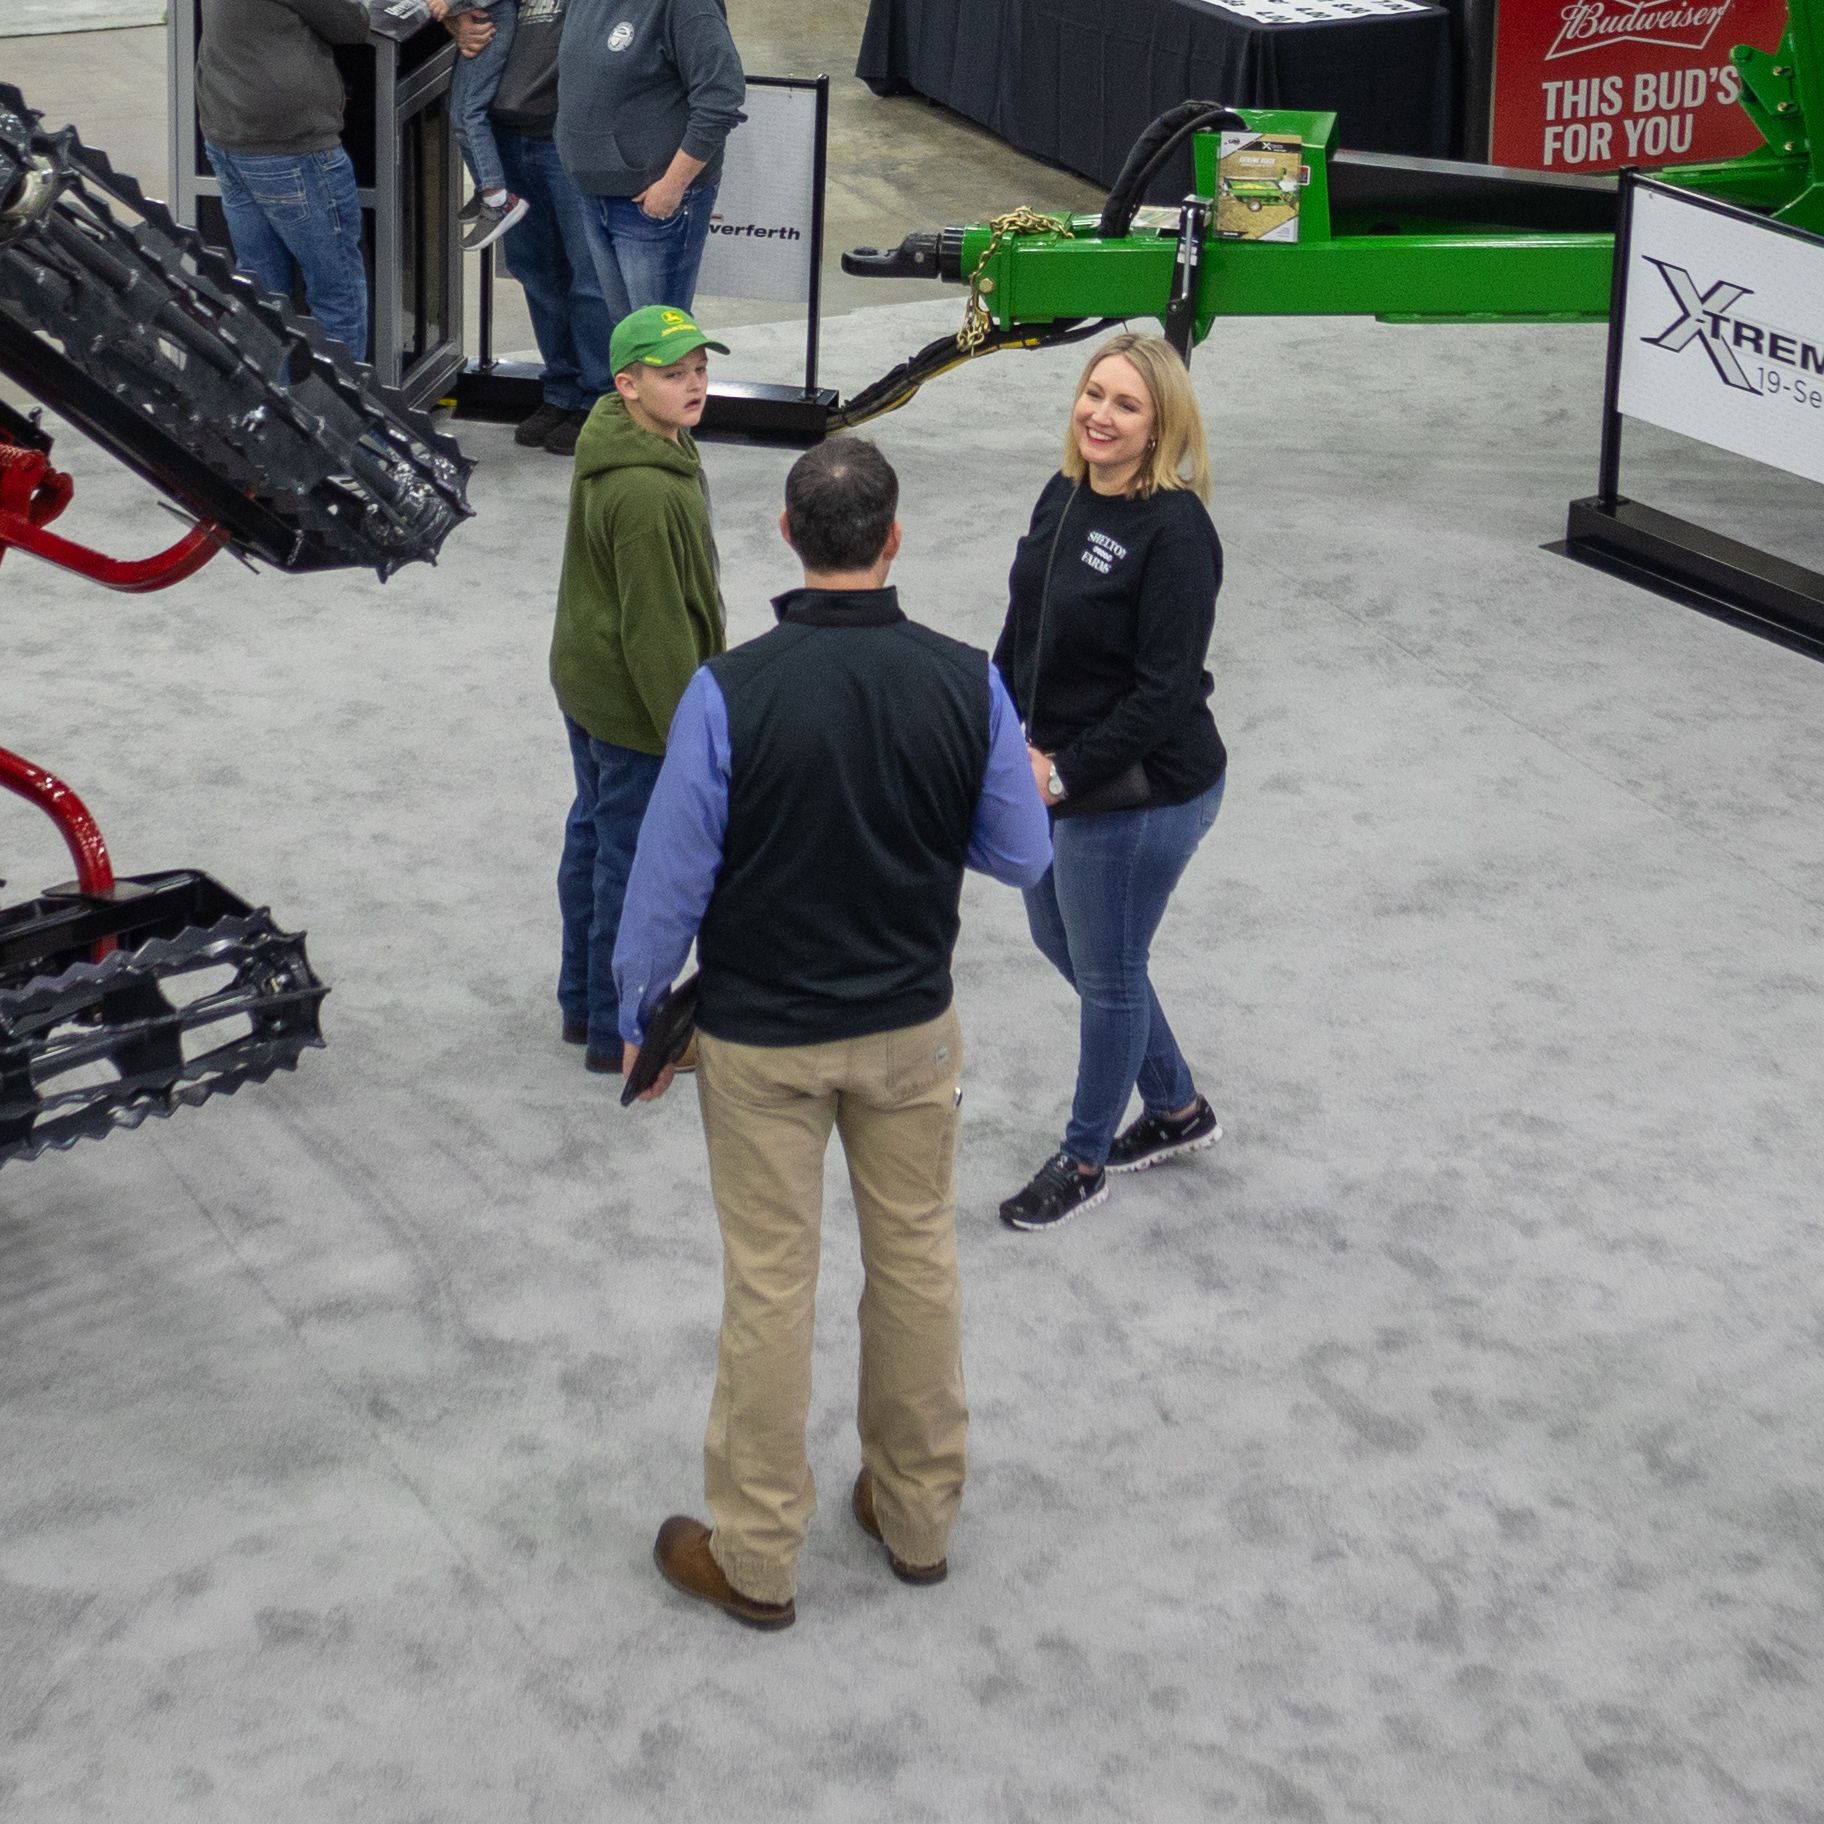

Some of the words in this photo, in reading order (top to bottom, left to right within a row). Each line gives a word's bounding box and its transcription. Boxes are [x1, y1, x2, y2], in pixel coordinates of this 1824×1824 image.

[1560, 0, 1726, 40] Budweiser
[1541, 75, 1624, 121] THIS
[1633, 65, 1743, 113] BUD'S
[1543, 120, 1613, 166] FOR
[1623, 113, 1694, 158] YOU
[709, 223, 801, 241] verferth
